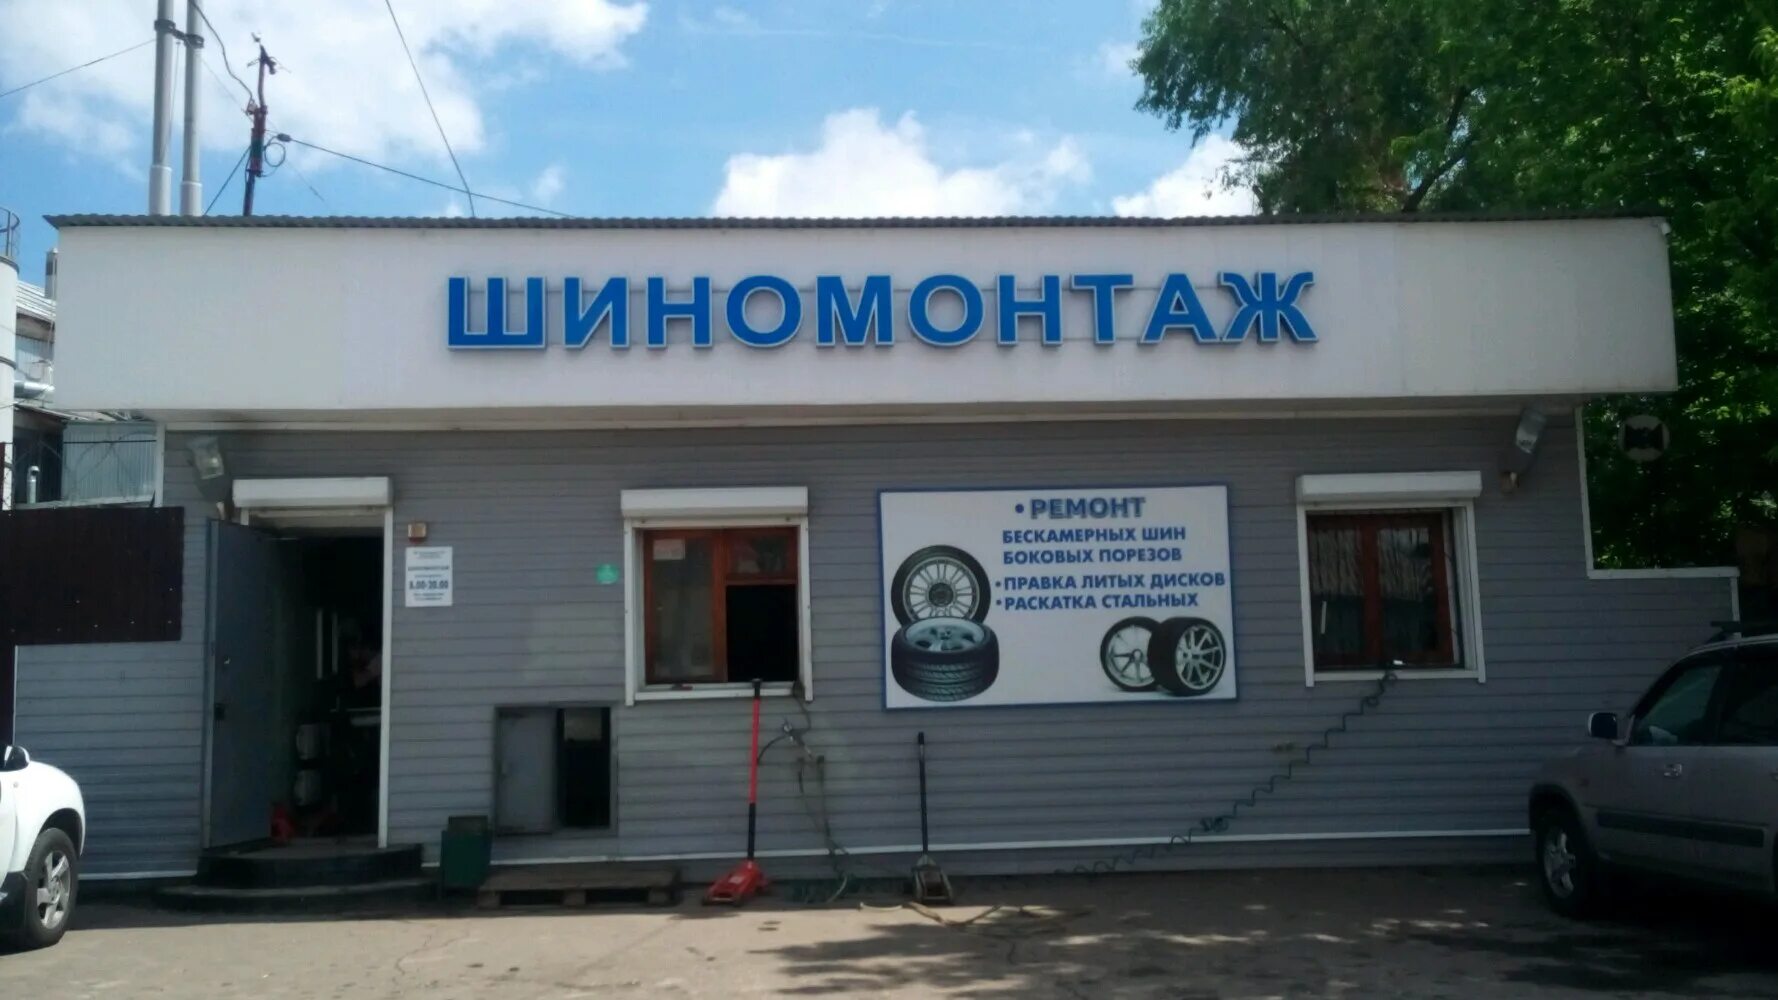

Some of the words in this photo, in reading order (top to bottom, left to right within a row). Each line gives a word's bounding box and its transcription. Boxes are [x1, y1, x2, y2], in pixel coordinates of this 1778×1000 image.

[447, 272, 1318, 350] ШИНОМОНТАЖ
[1030, 496, 1146, 520] РЕМОНТ
[1002, 528, 1137, 544] БЕСКАМЕРНЫХ
[1142, 526, 1186, 541] ШИН
[1003, 549, 1093, 565] БОКОВЫХ
[1099, 547, 1182, 563] ПОРЕЗОВ
[1004, 575, 1077, 591] ПРАВКА
[1081, 574, 1145, 589] ЛИТЫХ
[1150, 572, 1225, 589] ДИСКОВ
[1004, 595, 1097, 611] РАСКАТКА
[1101, 592, 1198, 609] СТАЛЬНЫХ
